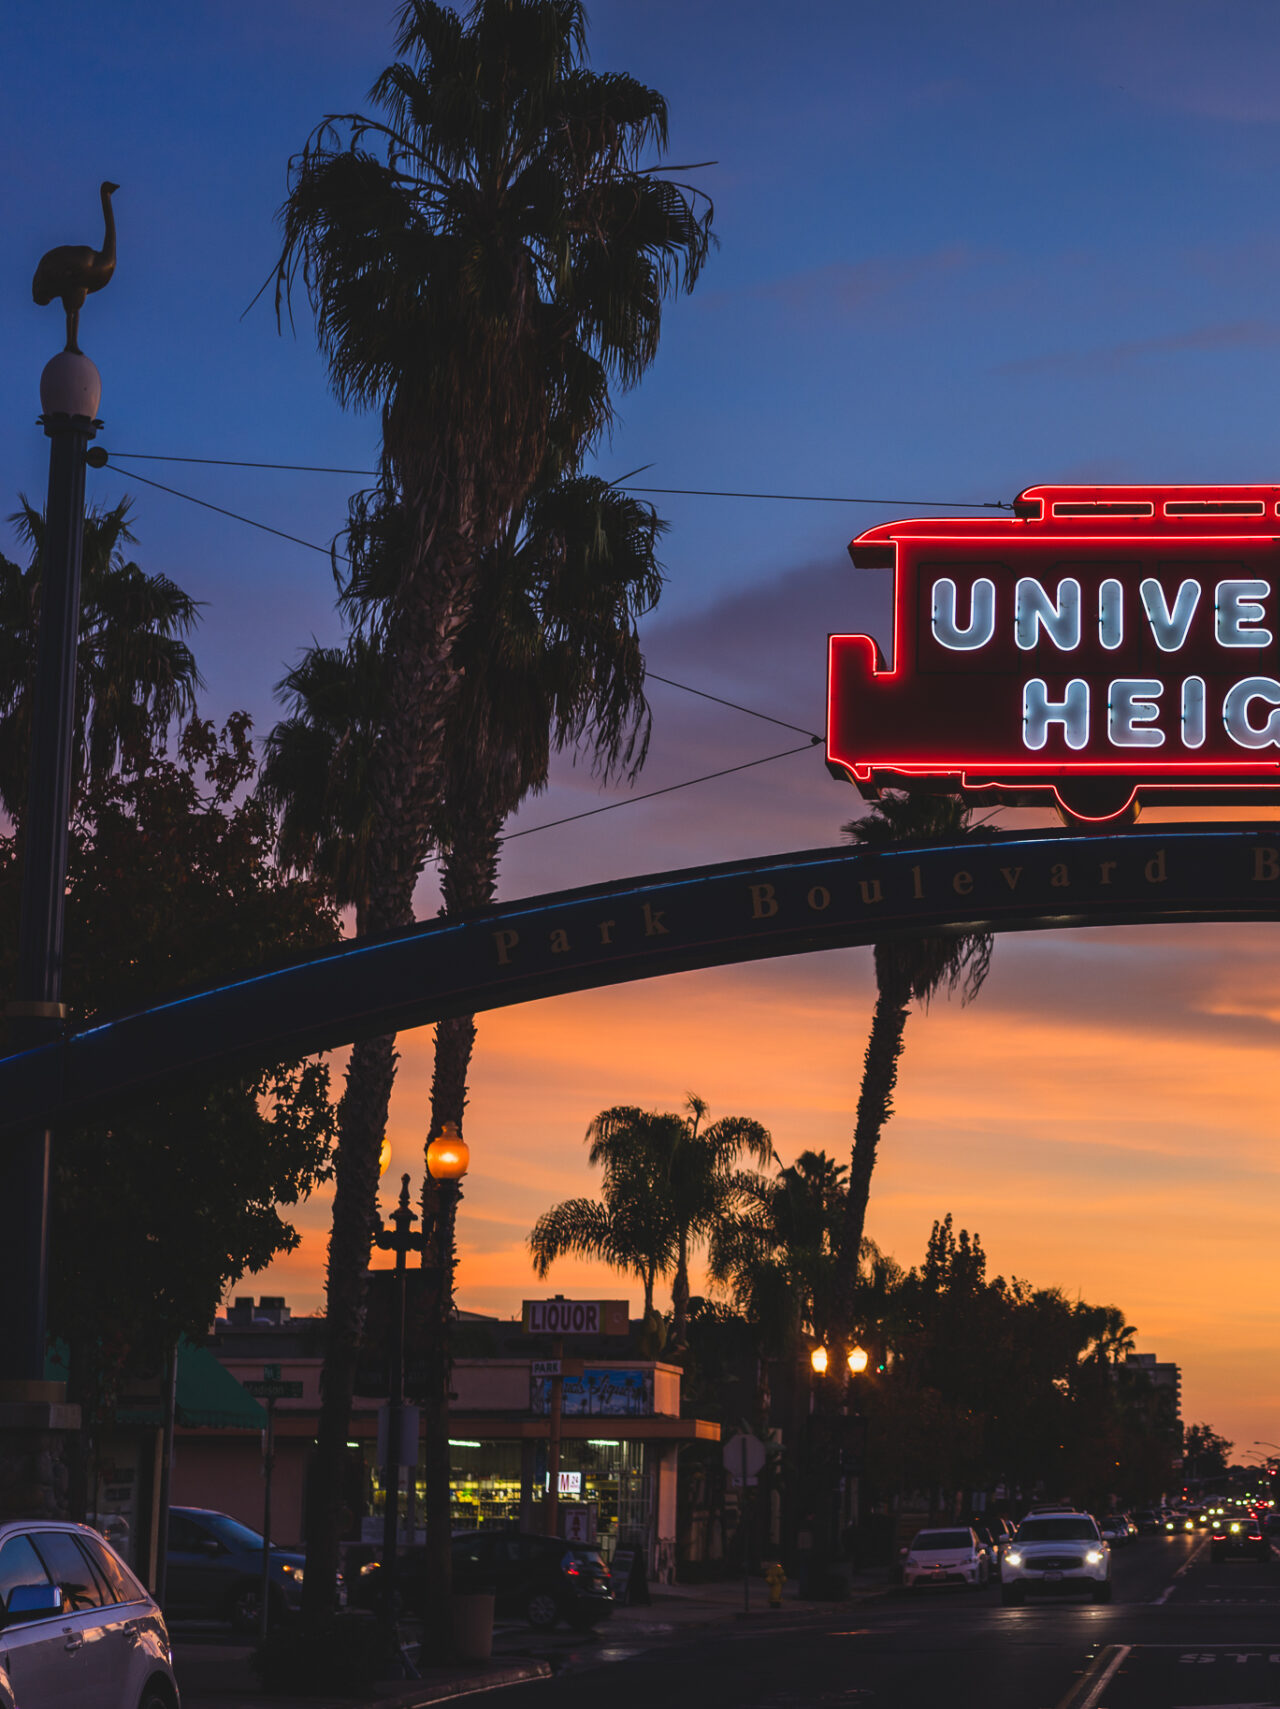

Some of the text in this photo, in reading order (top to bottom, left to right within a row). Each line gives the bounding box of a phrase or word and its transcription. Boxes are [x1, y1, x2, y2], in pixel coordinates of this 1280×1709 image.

[492, 902, 670, 966] Park
[748, 848, 1168, 921] Boulevard
[530, 1304, 598, 1331] LIQUOR
[534, 1362, 559, 1373] PARK
